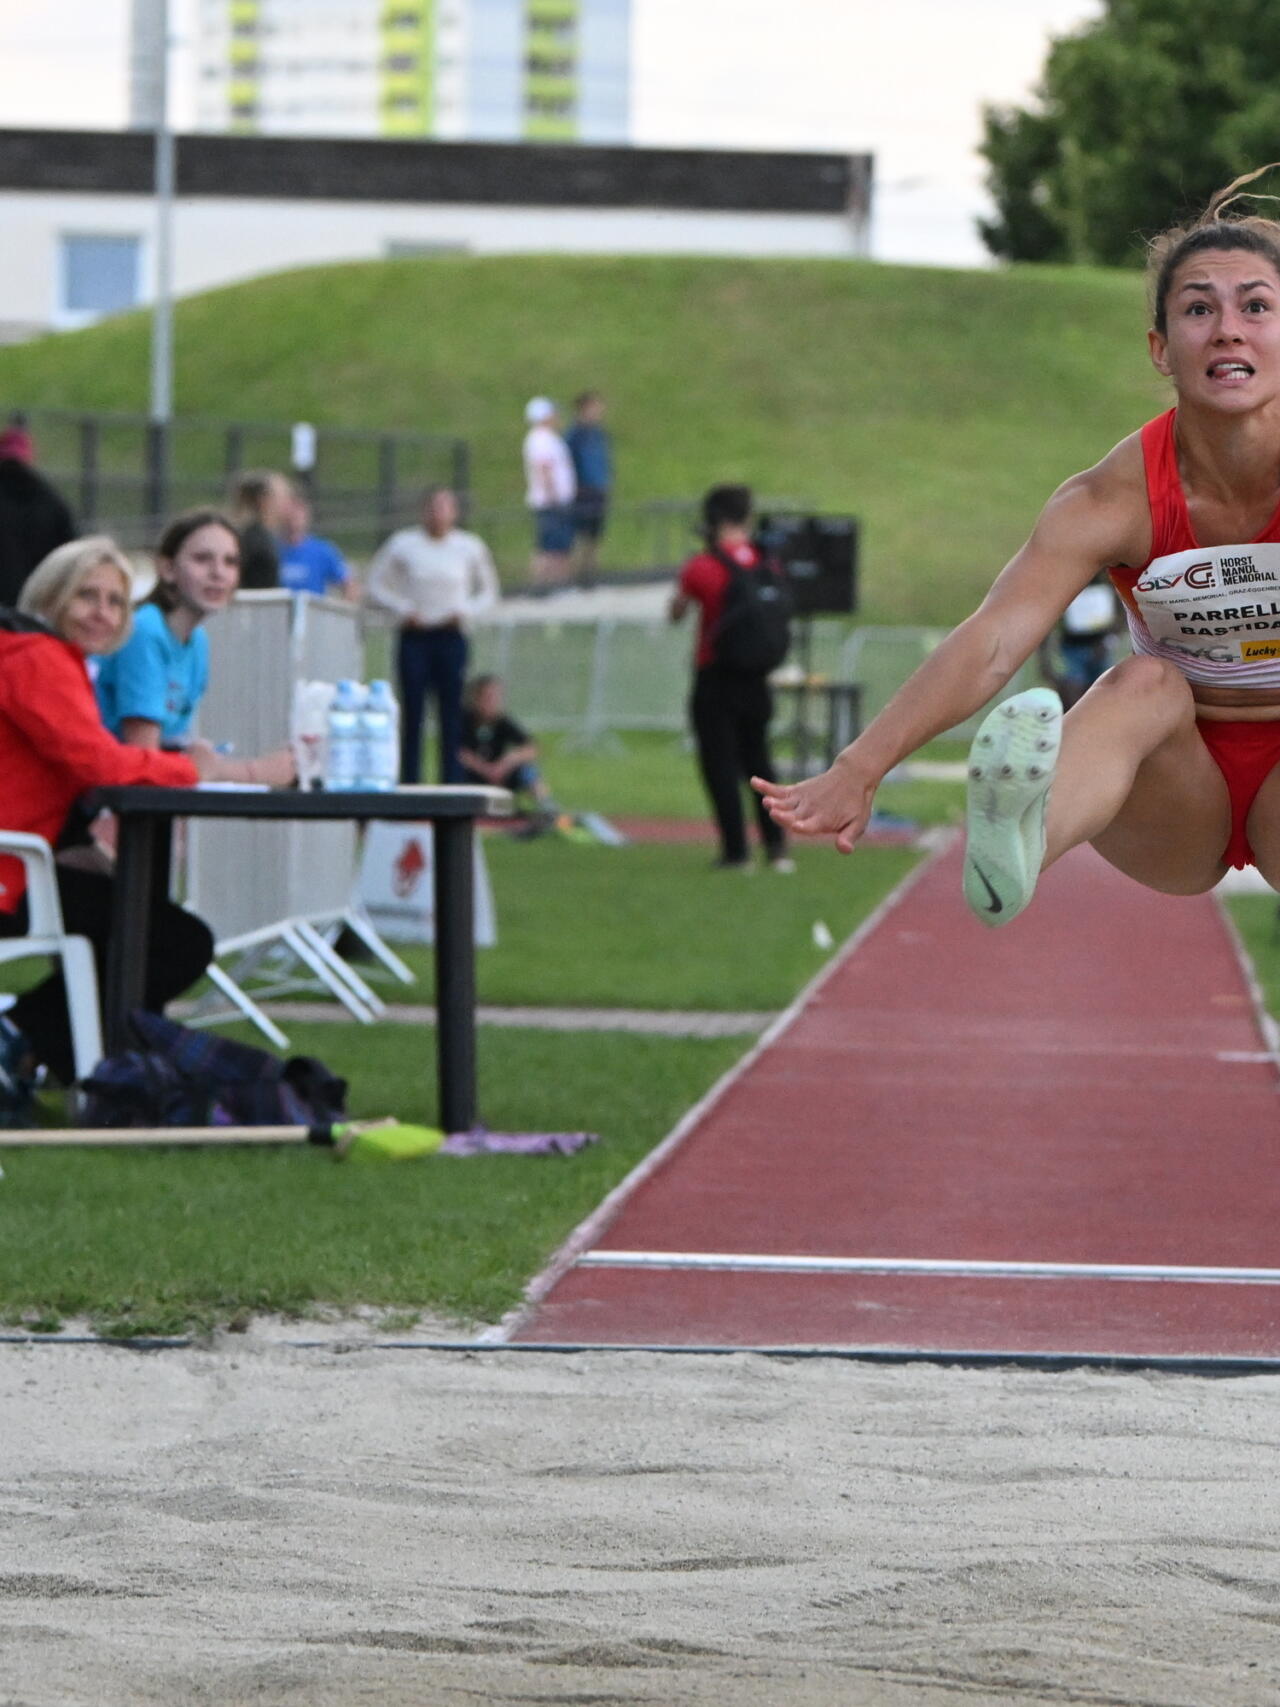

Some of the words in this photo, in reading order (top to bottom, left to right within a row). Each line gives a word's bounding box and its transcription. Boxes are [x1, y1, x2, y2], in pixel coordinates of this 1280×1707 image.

[1220, 556, 1253, 567] HORST
[1221, 564, 1259, 578] MANDL
[1223, 572, 1279, 586] MEMORIAL
[1245, 645, 1277, 657] Lucky
